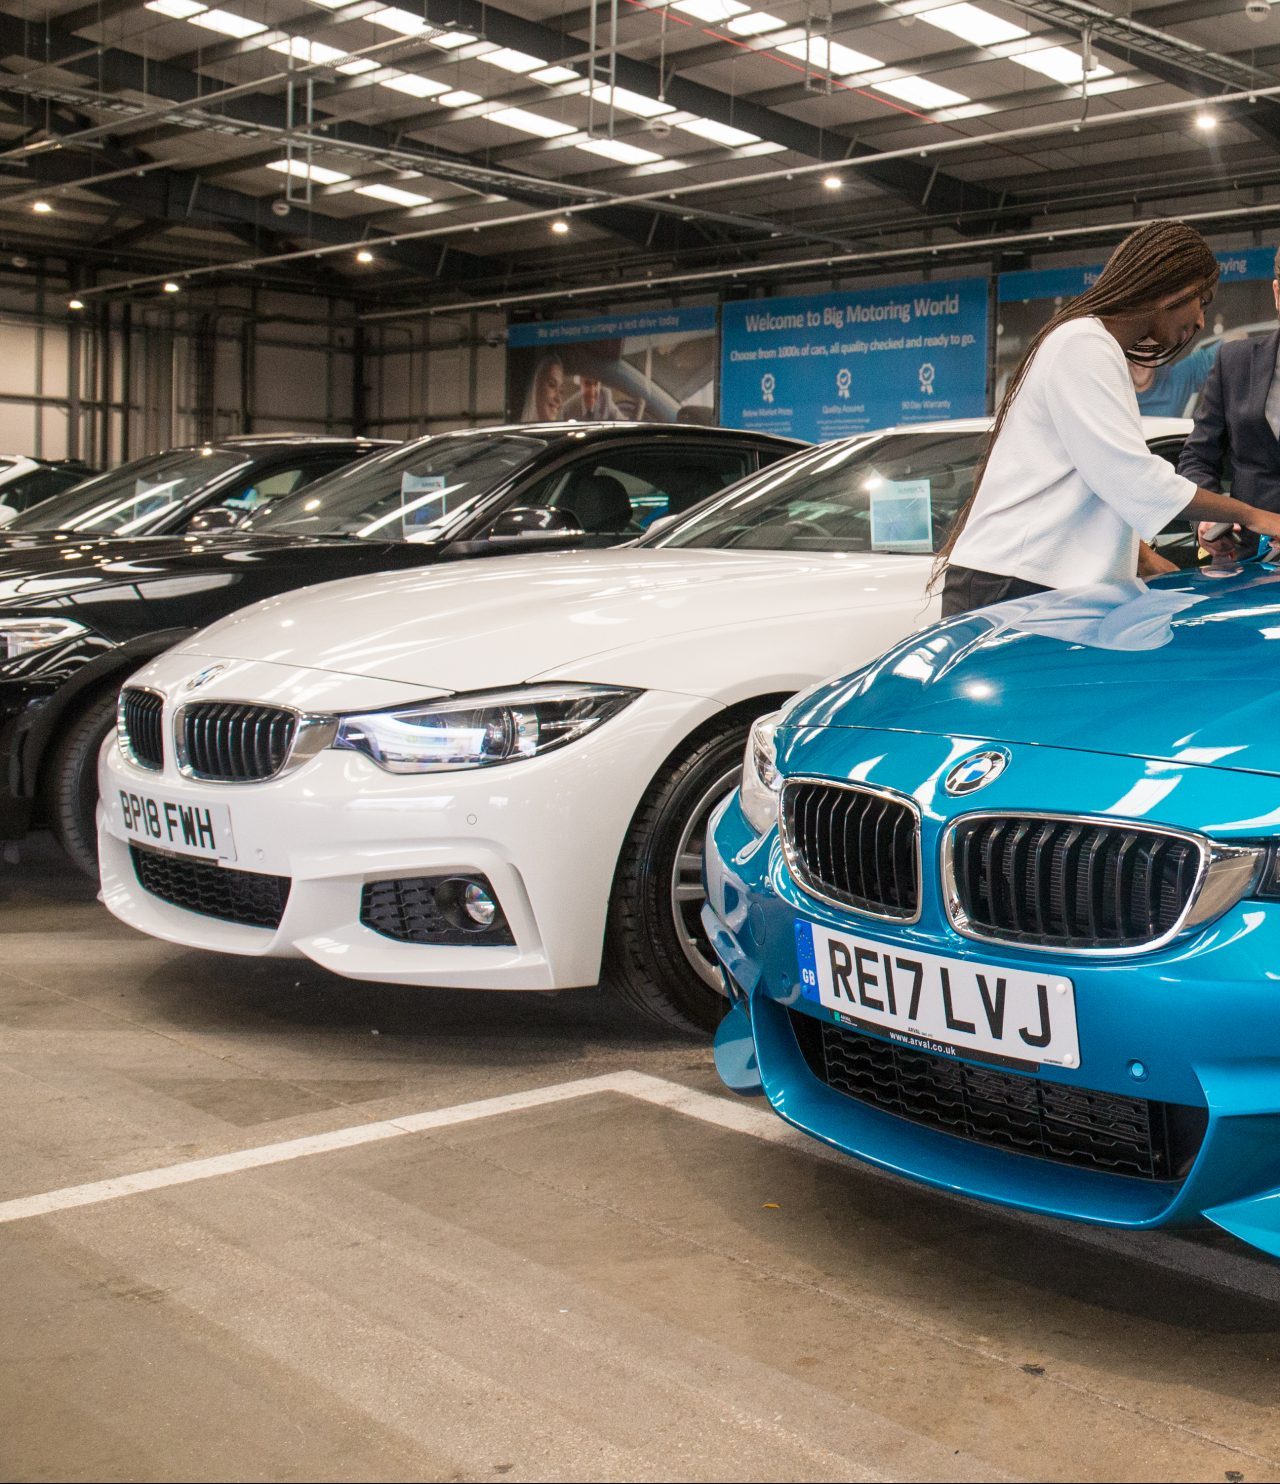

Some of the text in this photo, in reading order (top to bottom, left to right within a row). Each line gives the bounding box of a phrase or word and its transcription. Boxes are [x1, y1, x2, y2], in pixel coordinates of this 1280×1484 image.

[1216, 257, 1247, 275] aying
[745, 294, 959, 332] Welcome to Big Motoring World
[730, 350, 757, 361] Choose
[758, 347, 776, 359] from
[801, 343, 810, 356] of
[811, 345, 828, 357] cars,
[830, 341, 839, 354] all
[841, 340, 869, 355] quality
[870, 337, 904, 352] checked
[905, 335, 922, 348] and
[924, 333, 949, 348] ready
[950, 333, 960, 345] to
[961, 333, 976, 347] go.
[119, 790, 216, 850] BP18 FWH
[802, 967, 816, 985] GB
[827, 938, 1052, 1048] RE17 LVJ
[889, 1031, 957, 1056] www.arval.co.uk
